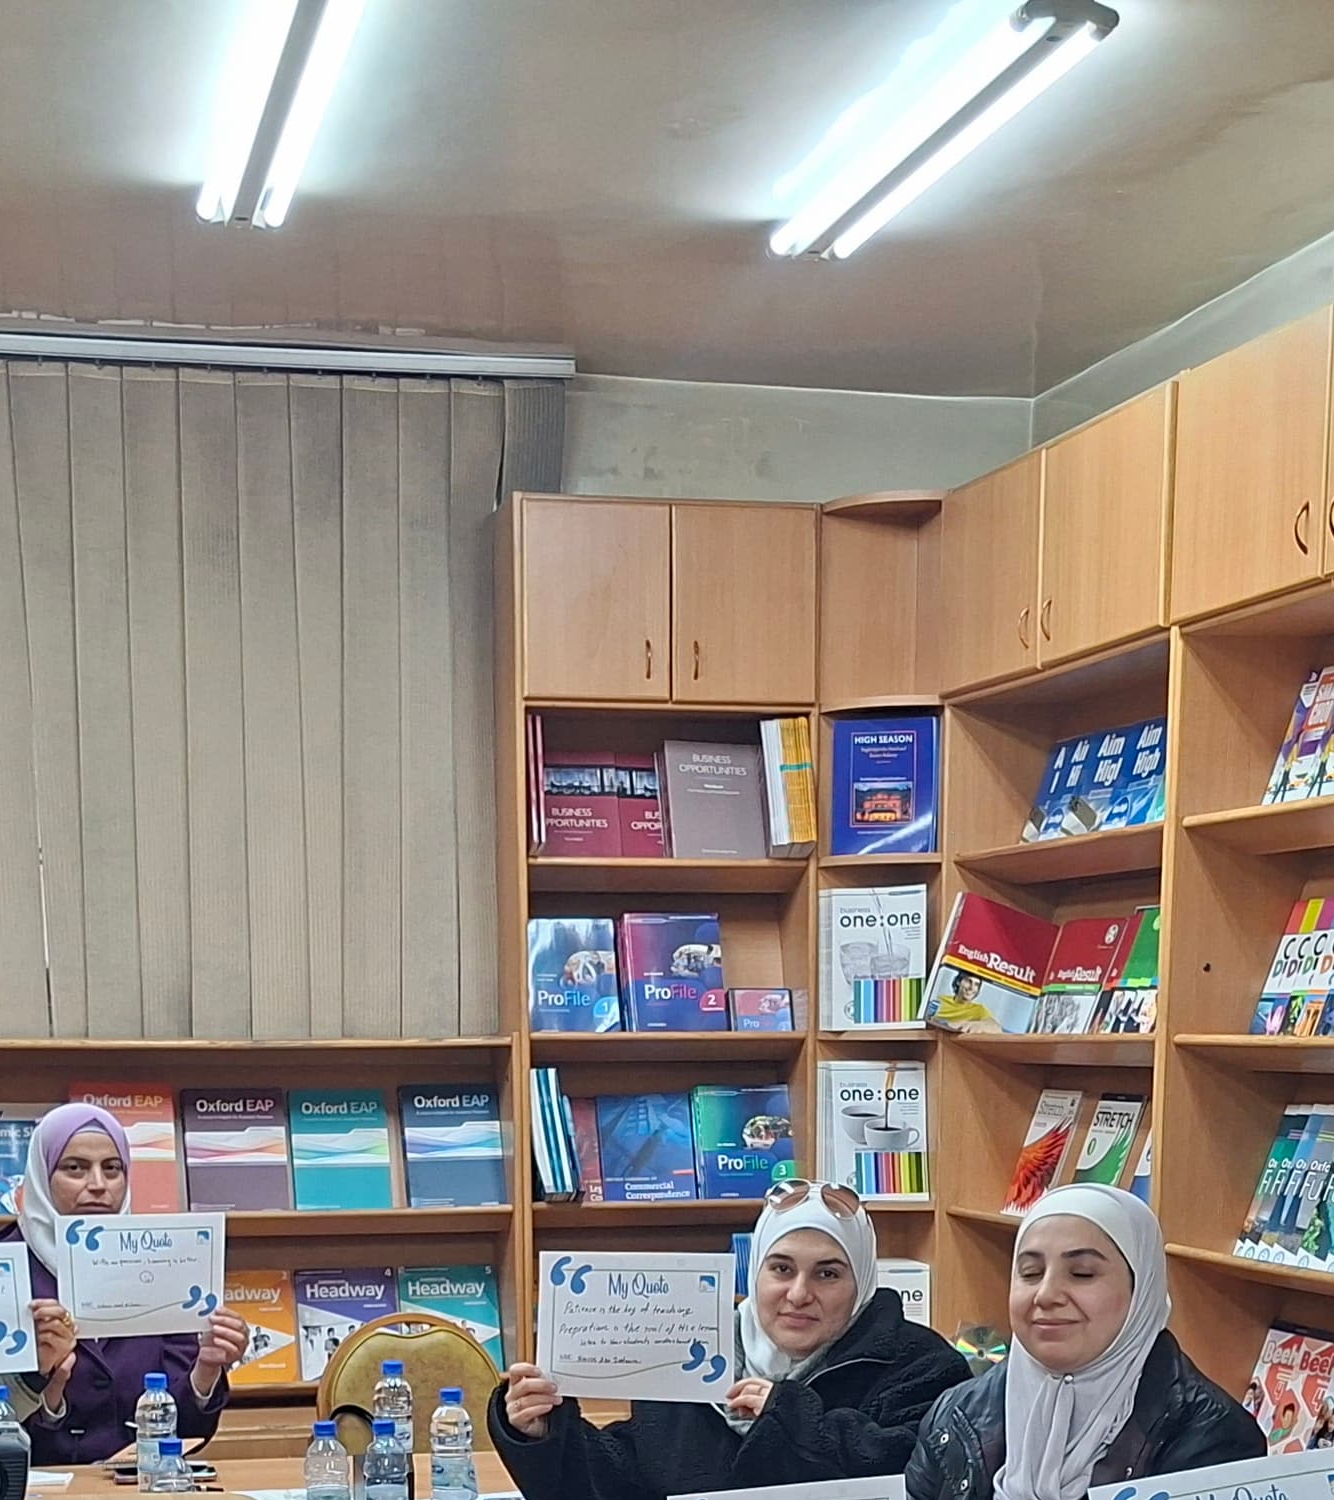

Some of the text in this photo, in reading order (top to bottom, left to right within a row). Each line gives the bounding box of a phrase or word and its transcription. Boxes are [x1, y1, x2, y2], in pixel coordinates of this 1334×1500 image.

[853, 732, 914, 745] HIGH SEASON
[1097, 733, 1126, 759] Aim
[1137, 723, 1163, 750] Aim
[691, 752, 732, 765] BUSINESS
[1132, 748, 1162, 777] High
[678, 762, 748, 777] OPPORTUNITIES
[551, 806, 593, 818] BUSINESS
[958, 943, 1036, 985] English Result
[537, 989, 592, 1009] ProFile
[644, 983, 718, 1007] ProFile 2
[133, 1094, 164, 1108] EAP
[196, 1098, 275, 1113] Oxford EAP
[301, 1100, 378, 1116] Oxford EAP
[413, 1093, 489, 1109] Oxford EAP
[1093, 1109, 1134, 1130] STRETCH
[717, 1154, 788, 1177] ProFile 3
[624, 1181, 675, 1192] Commercial
[624, 1190, 691, 1202] Correspondence
[120, 1230, 173, 1254] My Quote
[384, 1267, 393, 1278] 4
[484, 1264, 493, 1275] 5
[225, 1285, 281, 1304] adway
[305, 1282, 385, 1301] Headway
[407, 1280, 485, 1299] Headway
[609, 1272, 670, 1300] My Quote
